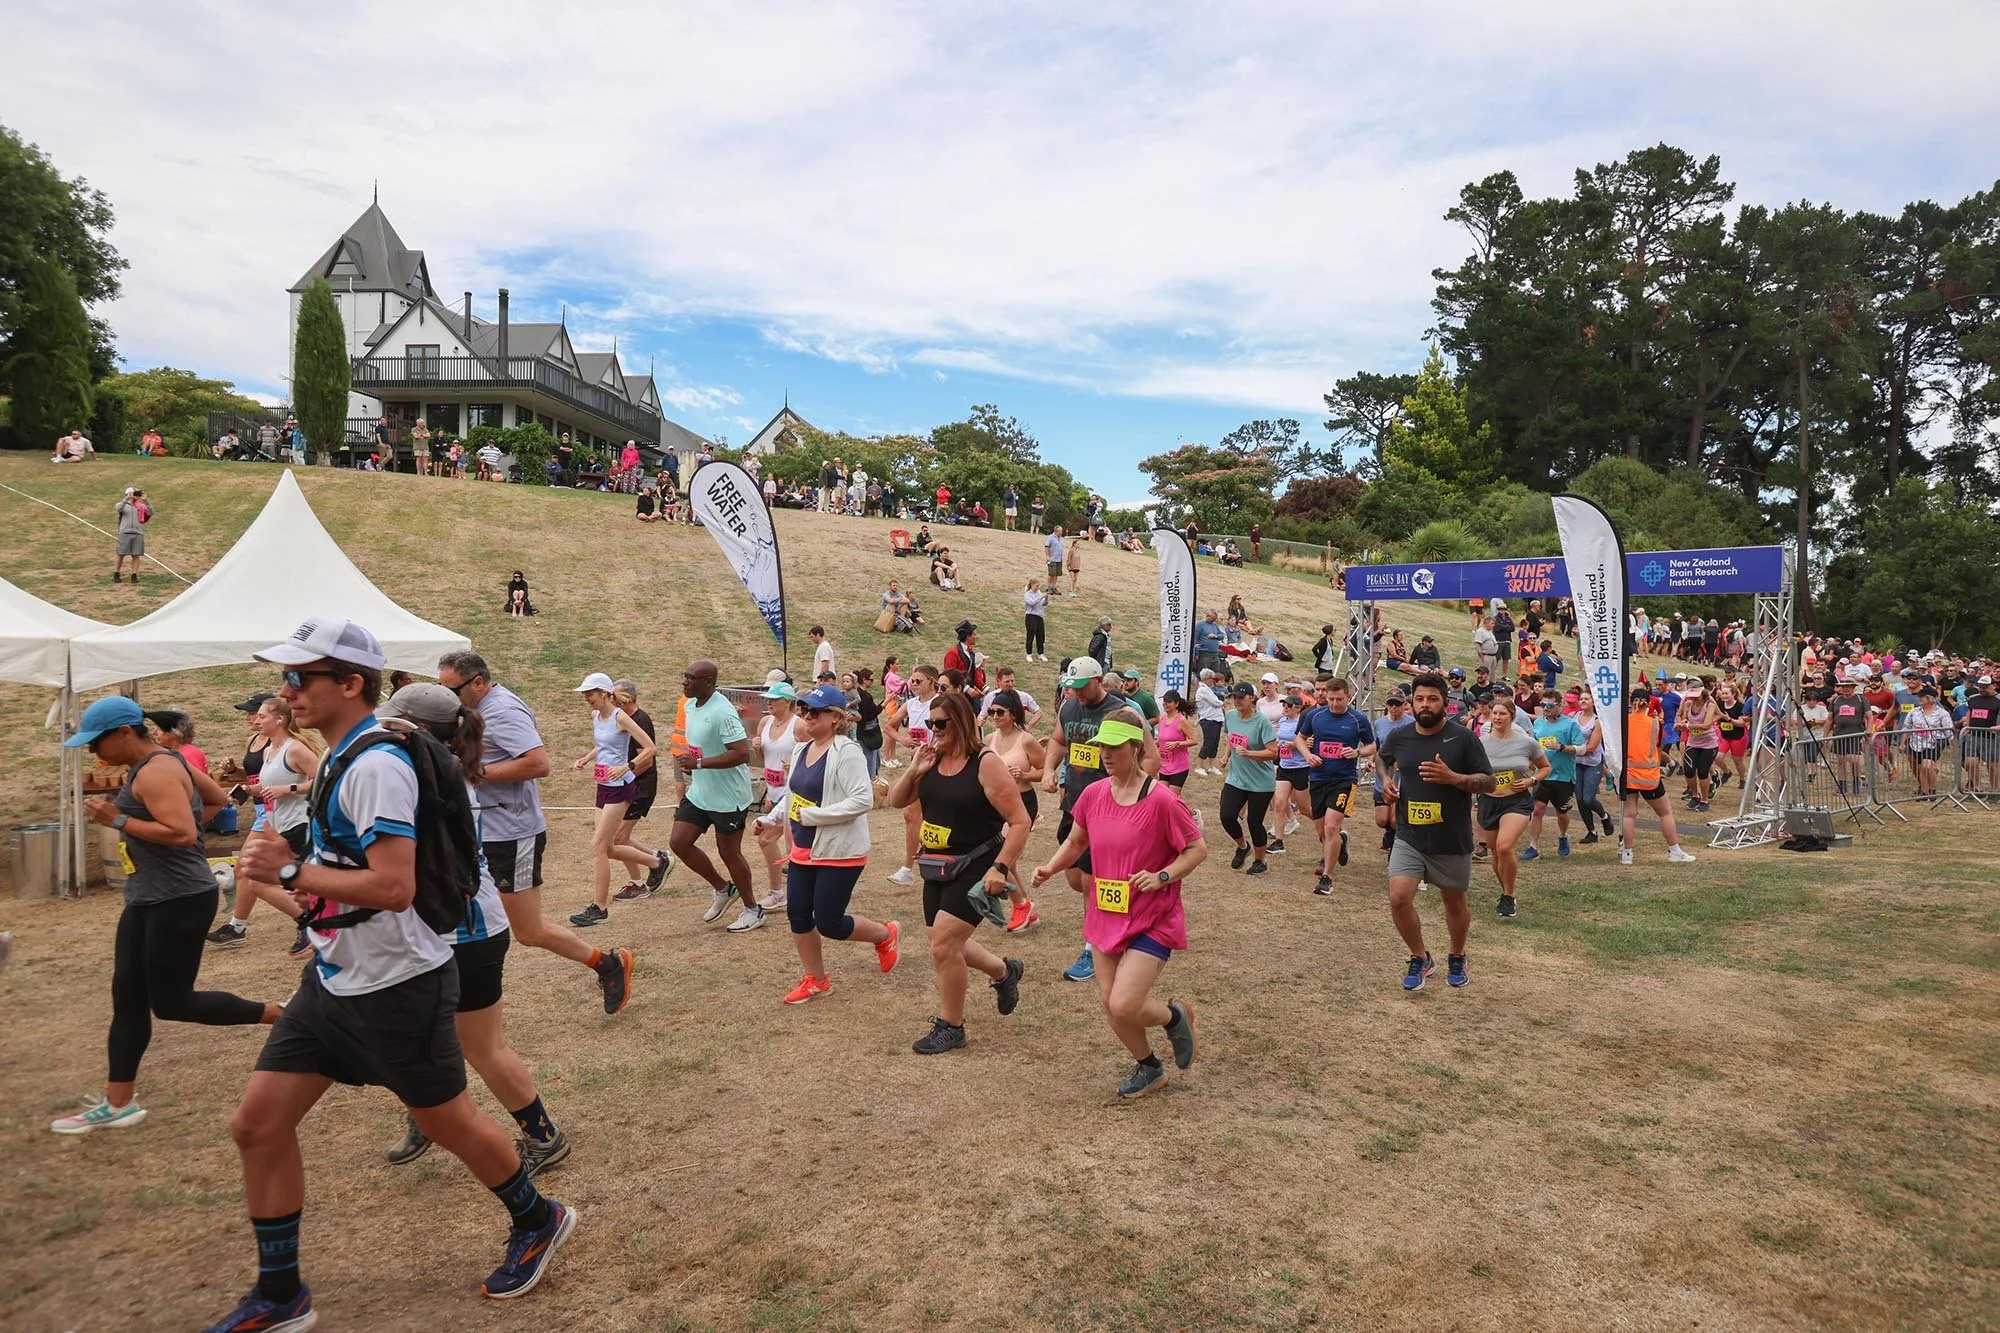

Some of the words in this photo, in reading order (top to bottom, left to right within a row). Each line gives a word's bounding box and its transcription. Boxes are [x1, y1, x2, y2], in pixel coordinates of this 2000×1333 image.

[716, 472, 747, 512] FREE
[706, 482, 747, 538] WATER
[1669, 559, 1690, 568] New
[1692, 557, 1731, 567] Zealand
[1507, 563, 1550, 578] VINE
[1669, 568, 1693, 577] Brain
[1695, 567, 1738, 576] Research
[1366, 573, 1394, 585] PEGASUS
[1396, 573, 1409, 585] BAY
[1508, 579, 1549, 592] RUN
[1669, 578, 1706, 587] Institute
[1171, 624, 1181, 653] Brain
[1596, 626, 1609, 660] Brain
[1230, 737, 1243, 746] 412
[1074, 749, 1091, 762] 798
[1323, 746, 1338, 755] 467
[1411, 808, 1432, 819] 759
[923, 829, 940, 845] 854
[1099, 888, 1122, 904] 758
